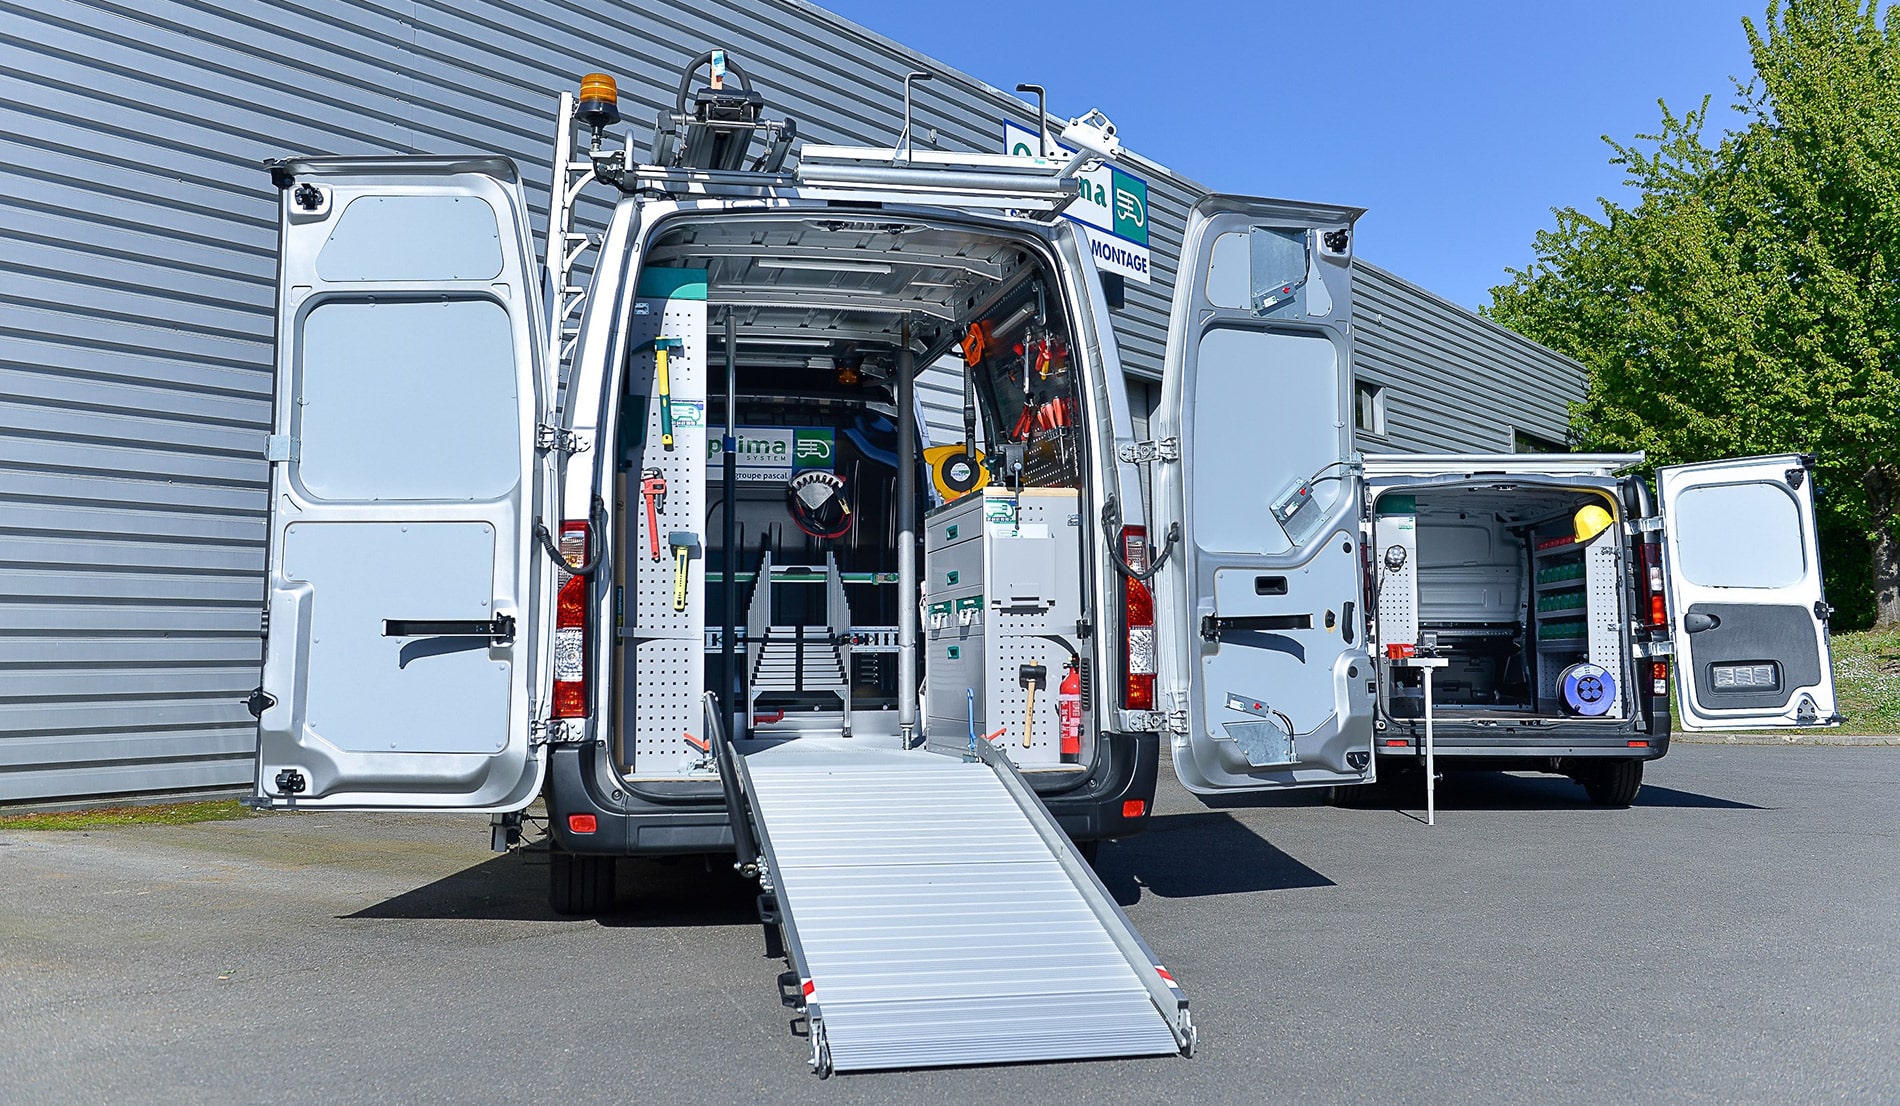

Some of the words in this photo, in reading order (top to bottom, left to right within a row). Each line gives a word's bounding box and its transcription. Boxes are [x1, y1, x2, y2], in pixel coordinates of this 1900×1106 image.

[1091, 239, 1147, 274] MONTAGE
[708, 435, 786, 459] pima
[763, 472, 788, 481] pascal
